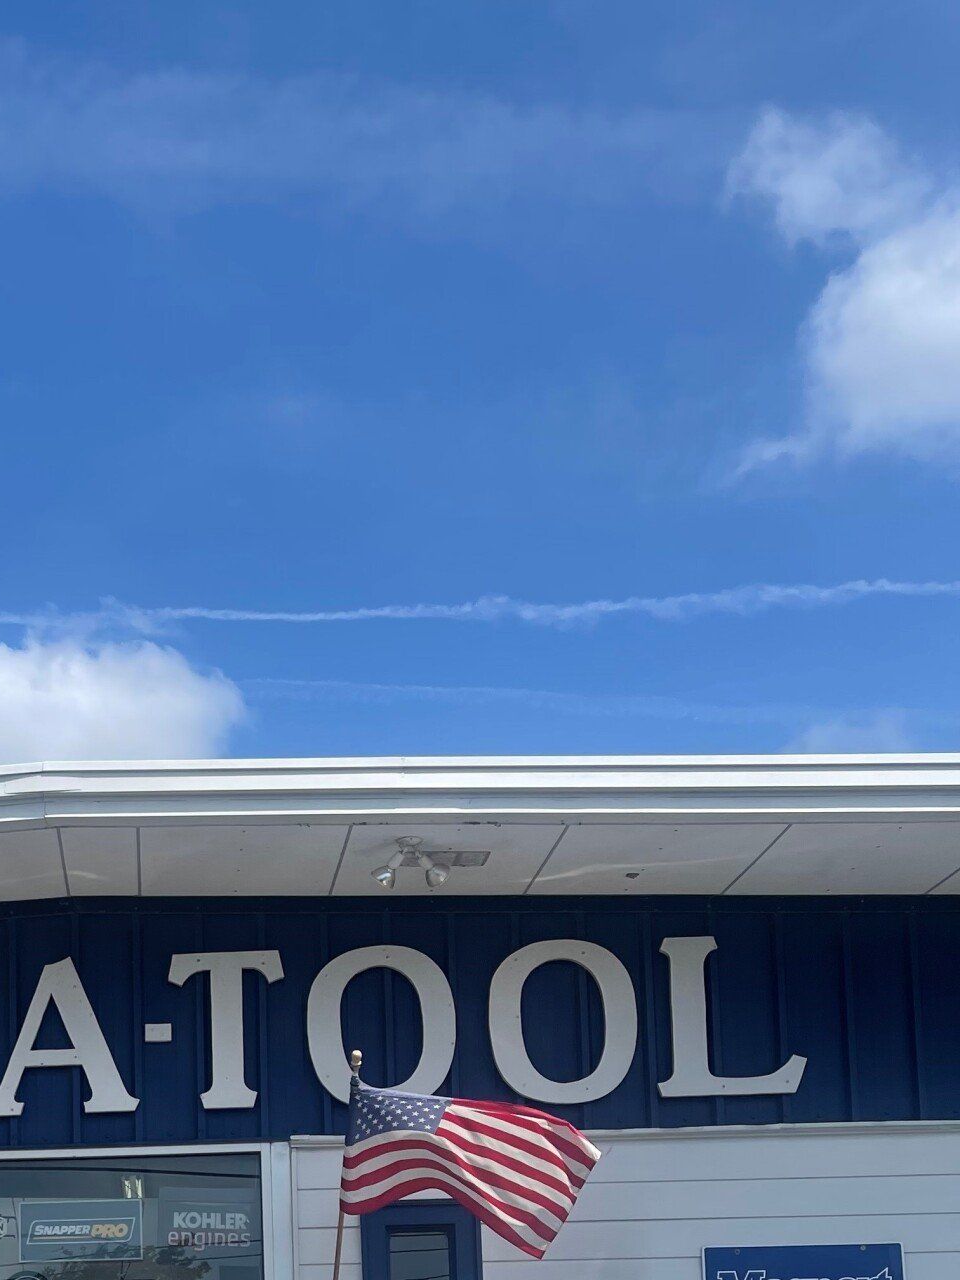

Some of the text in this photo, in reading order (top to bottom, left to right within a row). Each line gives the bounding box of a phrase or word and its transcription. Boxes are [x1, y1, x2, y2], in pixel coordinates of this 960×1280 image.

[173, 1211, 247, 1230] KOHLER
[34, 1223, 129, 1238] SNAPPER PRO
[168, 1231, 251, 1251] engines
